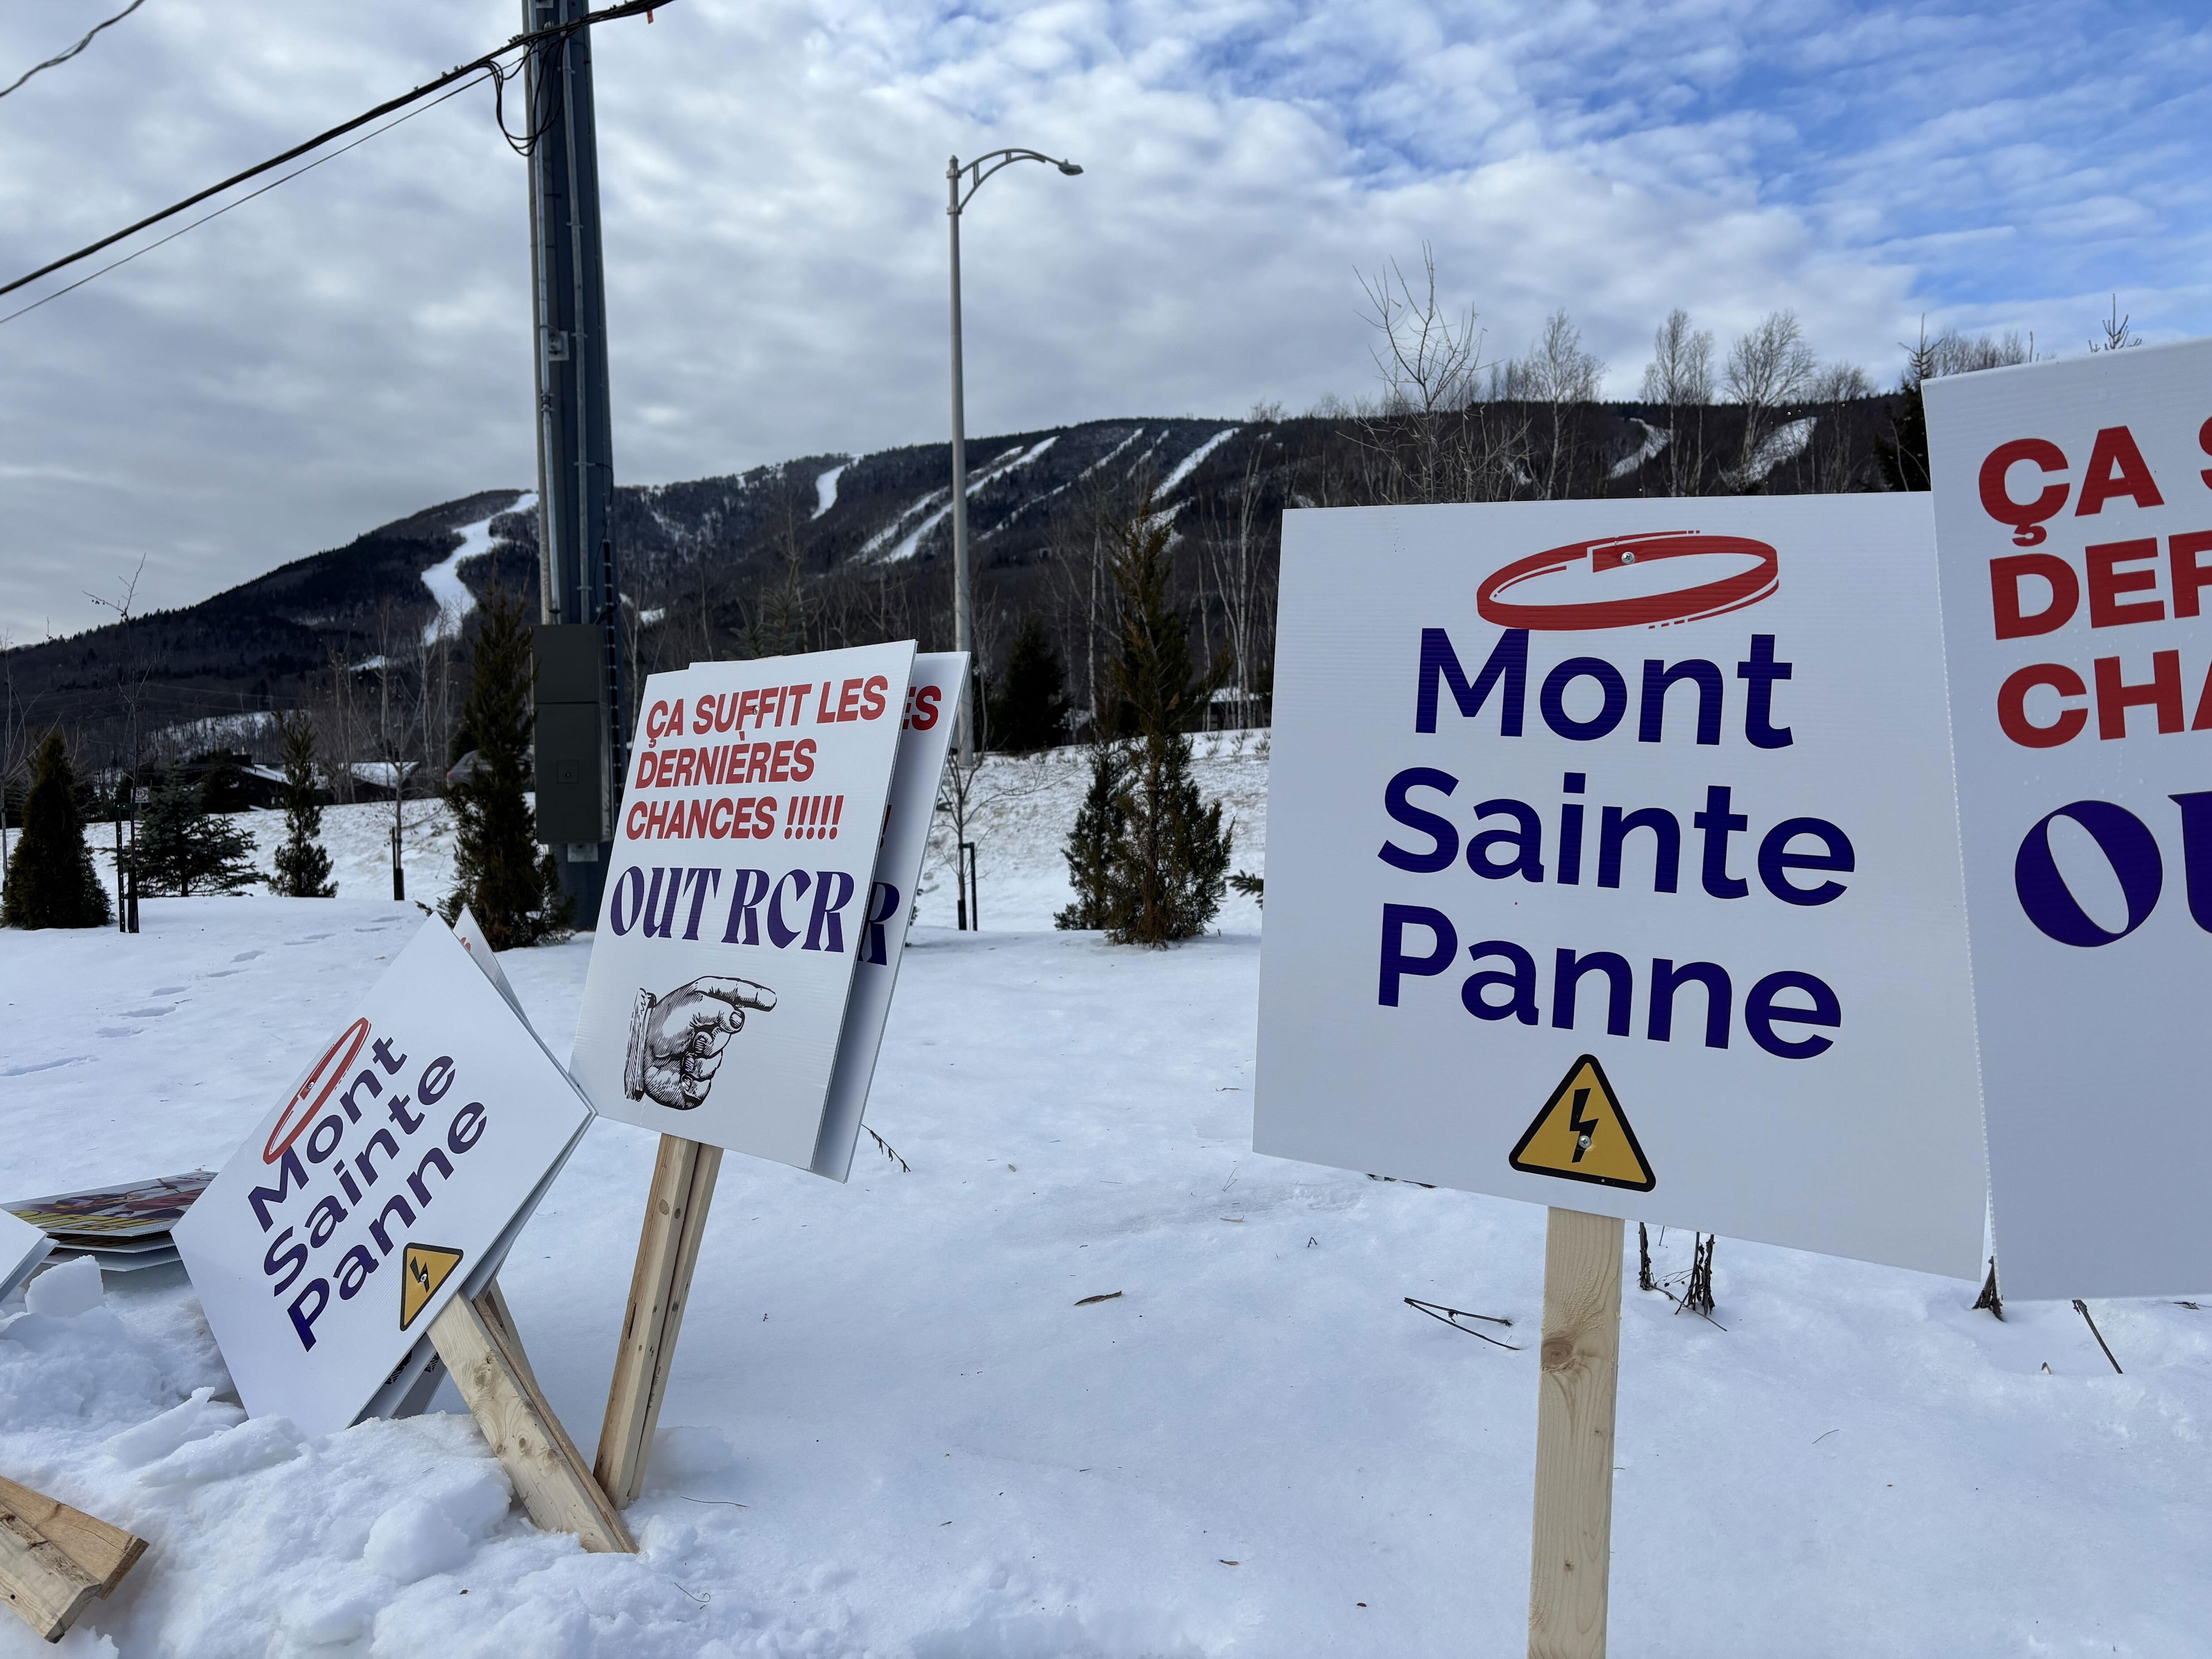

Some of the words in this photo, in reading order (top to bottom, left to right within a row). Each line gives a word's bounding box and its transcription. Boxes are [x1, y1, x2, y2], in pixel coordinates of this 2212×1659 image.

[1979, 426, 2165, 547] ÇA
[646, 698, 684, 749] ÇA
[693, 683, 812, 735] SUFFIT
[817, 675, 888, 724] LES
[1414, 627, 1795, 750] Mont
[1997, 649, 2212, 749] CH
[626, 796, 778, 841] CHANCES
[784, 795, 844, 841] !!!!!
[635, 731, 817, 789] DERNIÈRES
[1377, 766, 1856, 907] Sainte
[609, 866, 722, 941] OUT
[721, 869, 855, 953] RCR
[1377, 903, 1842, 1060] Panne
[247, 1036, 407, 1233] Mont
[263, 1055, 456, 1298] Sainte
[286, 1101, 488, 1352] Panne
